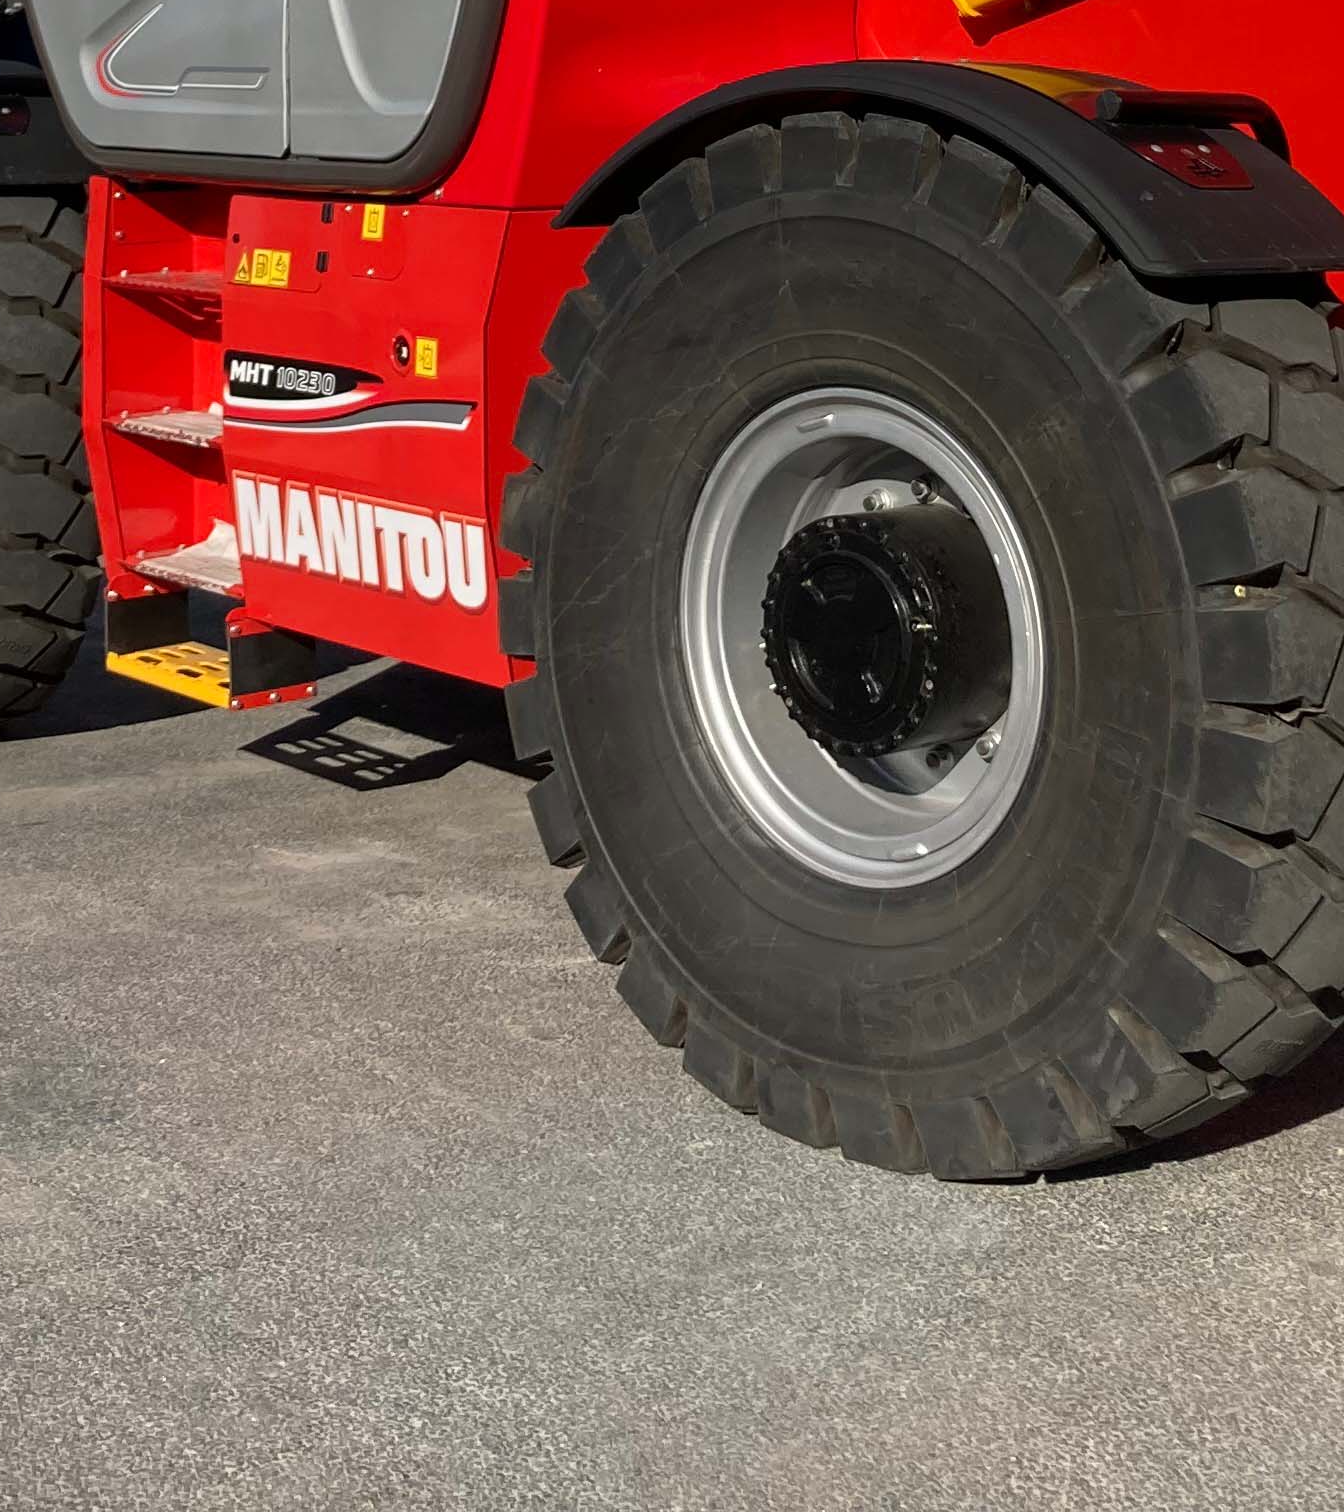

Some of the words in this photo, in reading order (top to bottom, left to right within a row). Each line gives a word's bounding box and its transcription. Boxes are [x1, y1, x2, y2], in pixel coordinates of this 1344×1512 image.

[230, 359, 274, 386] MHT
[276, 366, 337, 396] 10230
[232, 472, 489, 610] MANITOU
